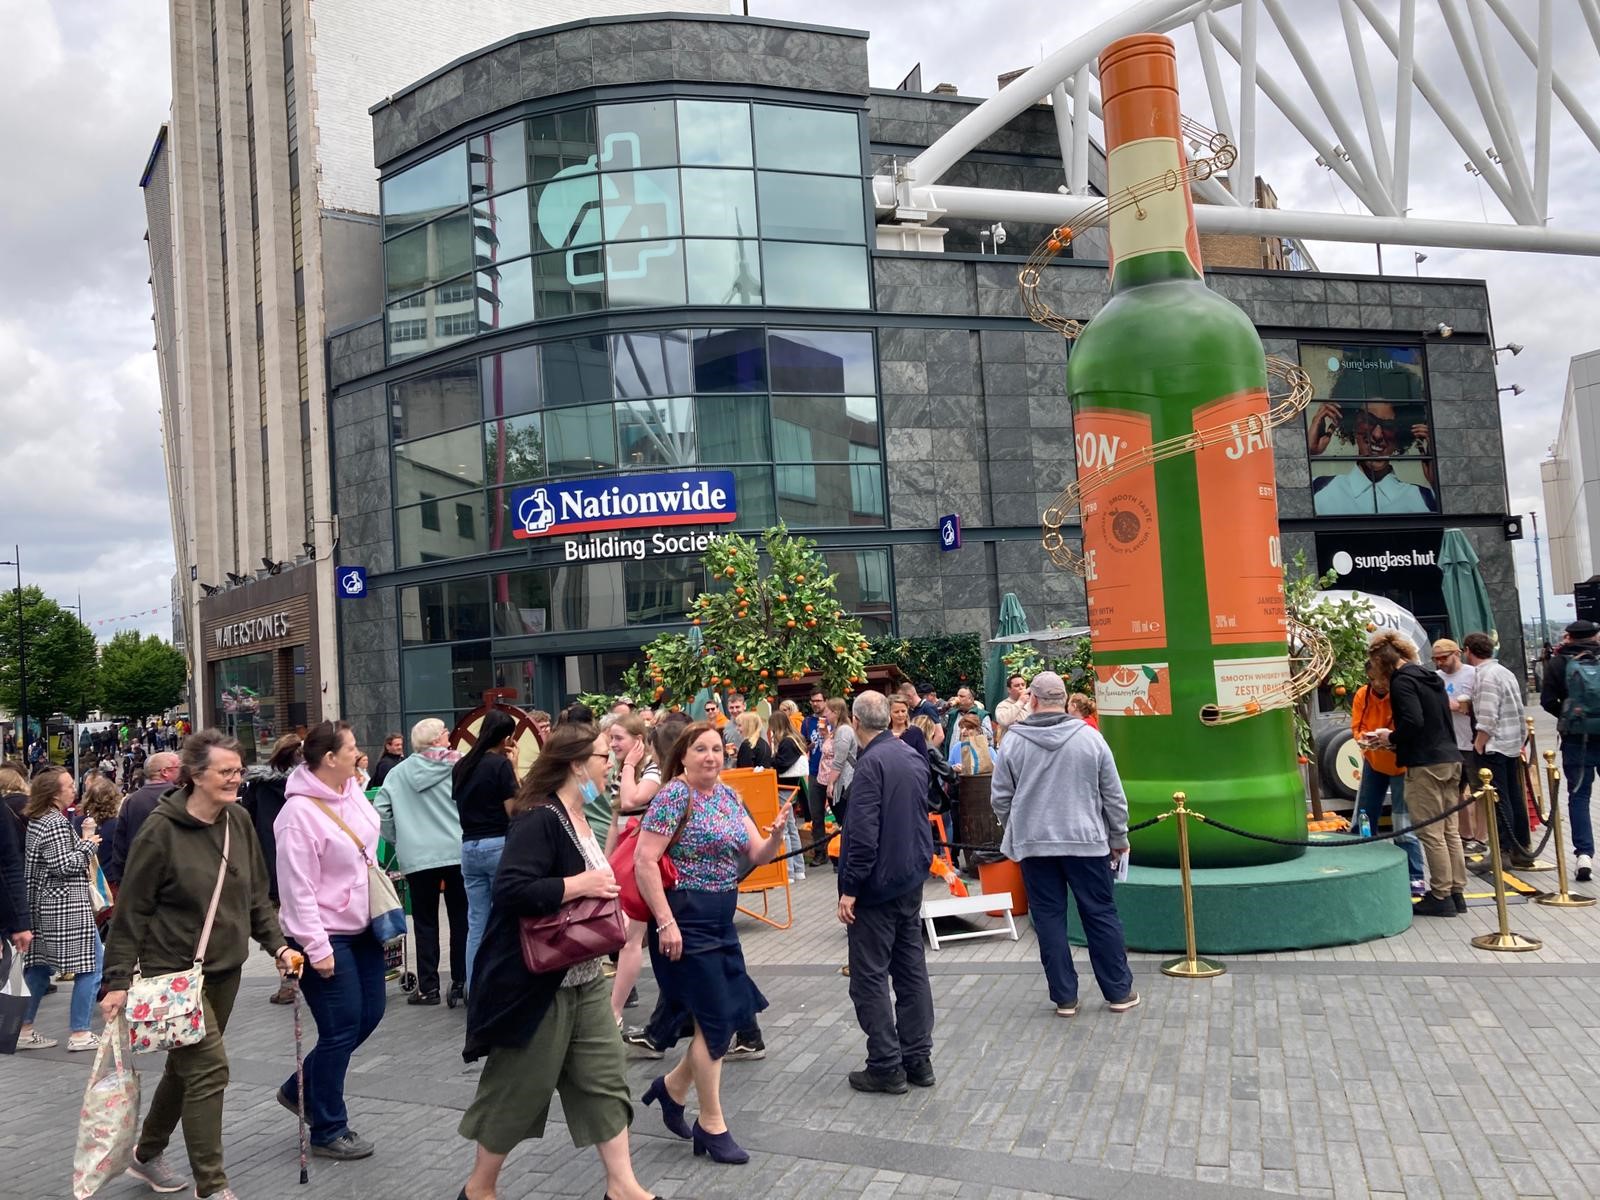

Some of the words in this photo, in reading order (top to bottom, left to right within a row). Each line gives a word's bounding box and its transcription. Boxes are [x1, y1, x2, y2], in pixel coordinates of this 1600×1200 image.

[1341, 359, 1379, 372] sunglass
[1380, 359, 1394, 369] hut
[559, 481, 727, 521] Nationwide
[564, 537, 646, 562] Building
[1355, 550, 1411, 572] sunglass
[1413, 549, 1436, 566] hut
[215, 612, 290, 649] WATERSTONES
[1220, 674, 1253, 683] SMOOTH
[1235, 685, 1260, 696] ZESTY
